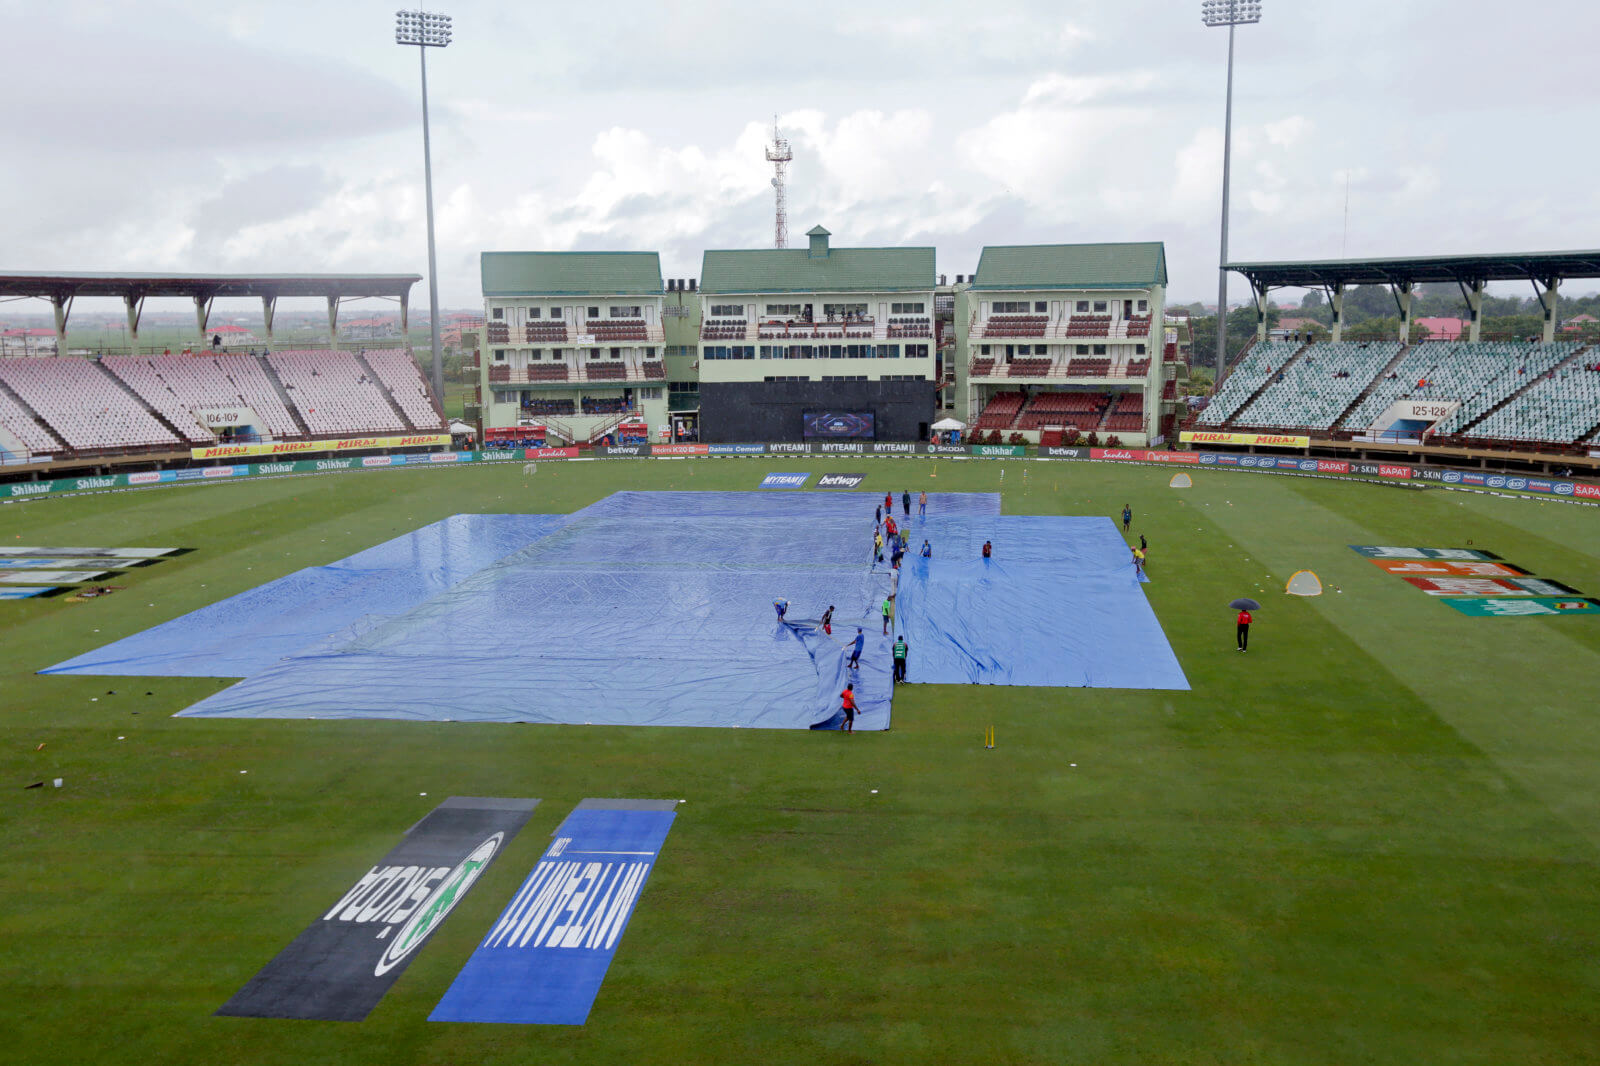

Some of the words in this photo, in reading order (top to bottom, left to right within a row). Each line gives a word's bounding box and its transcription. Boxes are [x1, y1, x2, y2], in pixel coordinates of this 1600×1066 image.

[1412, 406, 1446, 416] 125-128
[206, 412, 239, 423] 106-109
[400, 435, 440, 446] MIRAJ
[1191, 433, 1232, 442] MIRAJ
[1255, 435, 1297, 444] MIRAJ
[272, 442, 313, 453] MIRAJ
[336, 438, 377, 449] MIRAJ
[204, 446, 248, 458] MIRAJ
[537, 449, 567, 457] Sandals
[607, 446, 639, 455] betway
[981, 447, 1014, 455] Shikhar
[1048, 447, 1079, 457] betway
[1102, 450, 1132, 459] Sandals
[481, 451, 514, 461] Shikhar
[259, 463, 295, 475] Shikhar
[316, 459, 351, 471] Shikhar
[1319, 462, 1346, 471] SAPAT
[1361, 465, 1378, 473] SKIN
[1380, 466, 1408, 476] SAPAT
[1423, 471, 1441, 479] SKIN
[76, 477, 115, 489] Shikhar
[818, 475, 862, 486] betway
[11, 483, 51, 496] Shikhar
